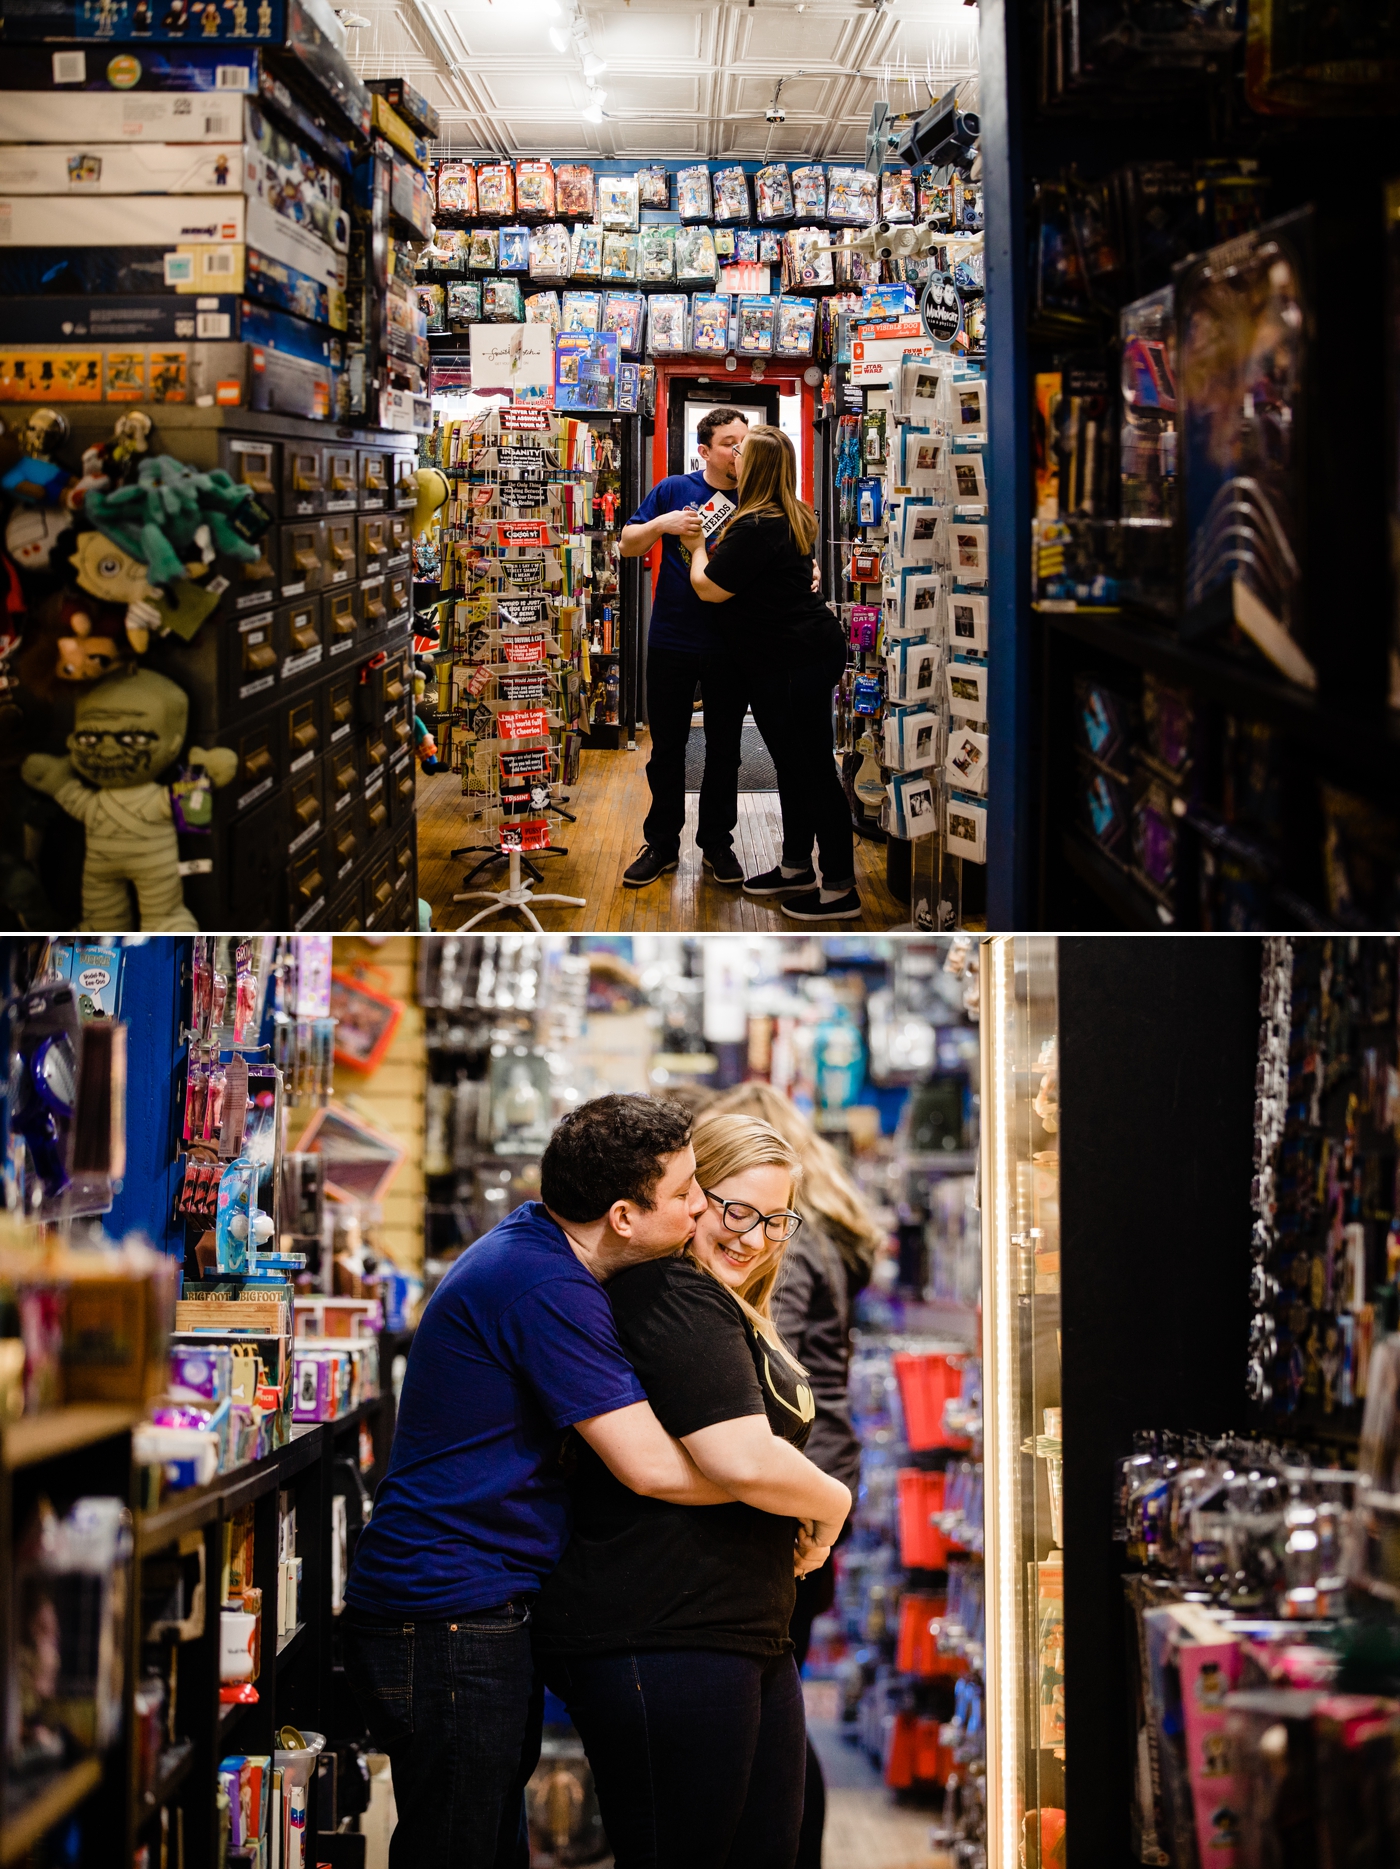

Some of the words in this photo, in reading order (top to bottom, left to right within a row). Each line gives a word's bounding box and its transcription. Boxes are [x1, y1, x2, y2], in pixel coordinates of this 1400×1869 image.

[726, 264, 762, 290] EXIT
[502, 448, 540, 456] INSANITY
[699, 511, 708, 520] I
[702, 504, 731, 533] NERDS
[532, 718, 542, 726] full
[508, 794, 528, 802] DSSENT
[80, 954, 110, 967] PICKLE
[187, 1292, 232, 1302] BIGFOOT
[239, 1290, 284, 1302] BIGFOOT
